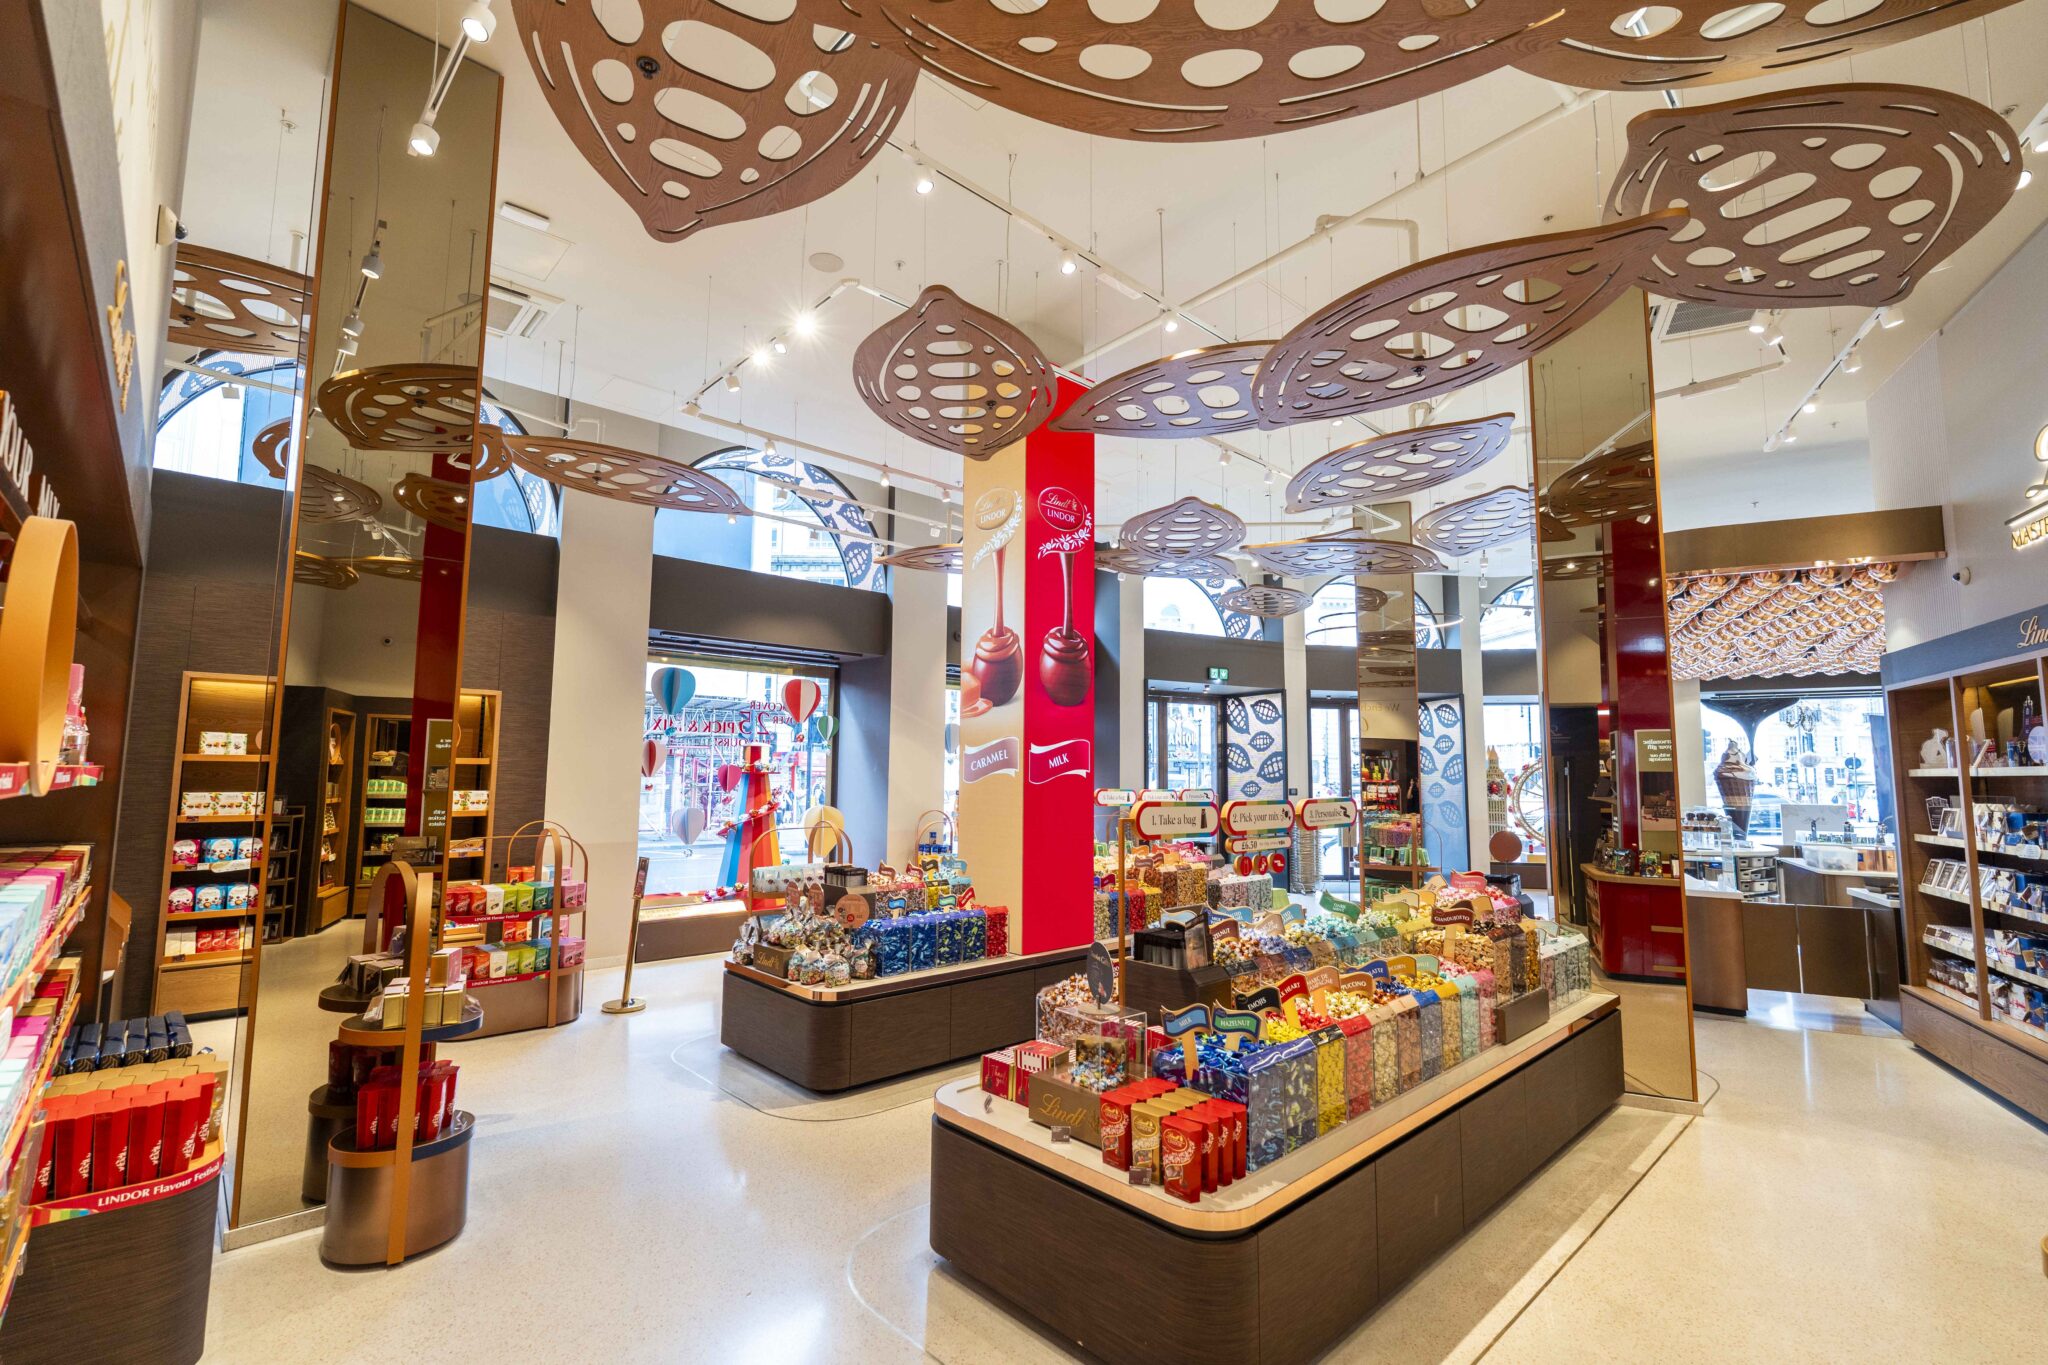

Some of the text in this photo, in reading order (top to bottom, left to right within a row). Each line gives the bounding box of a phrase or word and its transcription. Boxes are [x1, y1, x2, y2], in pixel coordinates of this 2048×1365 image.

[1045, 492, 1071, 509] Lindt
[980, 510, 1006, 524] LINDOR
[1047, 509, 1075, 523] LINDOR
[970, 750, 1009, 771] CARAMEL
[1049, 753, 1069, 769] MILK
[1151, 814, 1197, 826] 1. Take a bag
[1240, 813, 1252, 823] Pick
[1253, 814, 1267, 824] your
[1268, 812, 1279, 821] mix
[1241, 840, 1258, 850] £6.50
[1285, 982, 1300, 994] HEART
[1247, 996, 1267, 1011] EMOJIS
[1220, 1019, 1251, 1027] HAZELNUT
[1040, 1093, 1087, 1127] Lindt
[98, 1162, 220, 1207] LINDOR Flavour Festival
